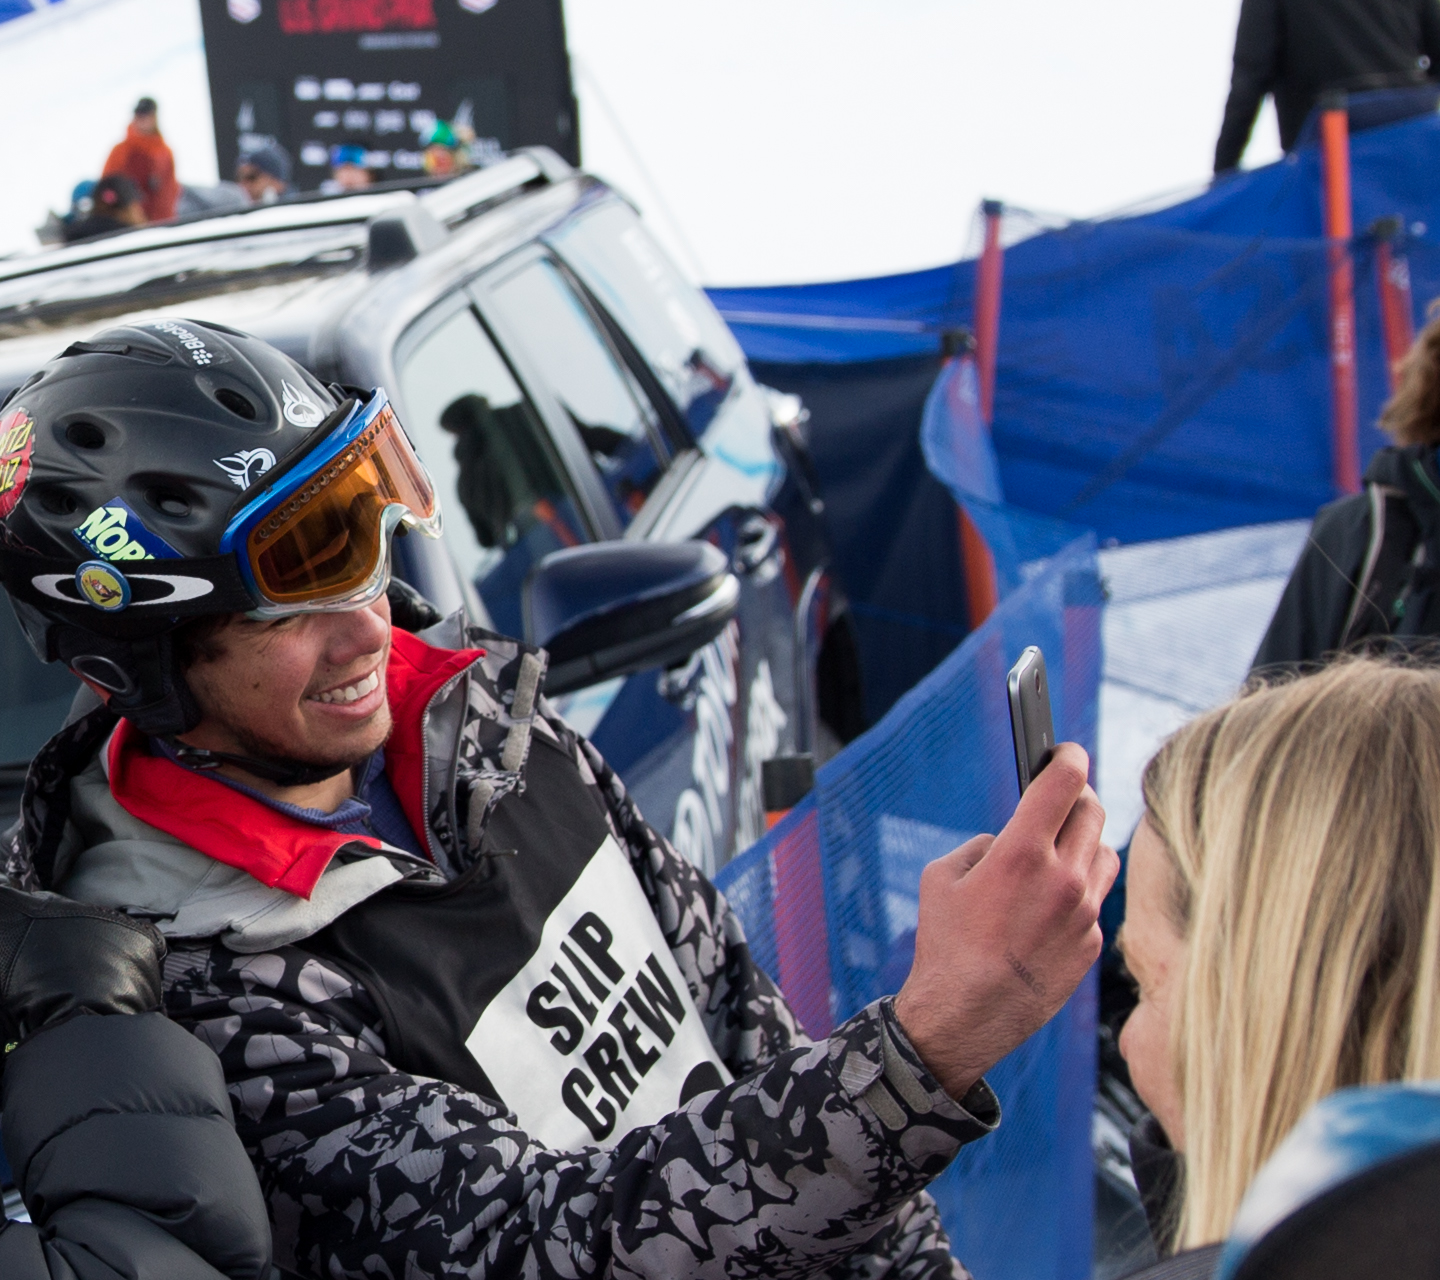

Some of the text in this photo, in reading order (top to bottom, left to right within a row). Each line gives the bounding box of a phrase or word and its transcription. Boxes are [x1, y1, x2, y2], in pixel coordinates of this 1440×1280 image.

[79, 506, 156, 560] NOR
[526, 911, 626, 1056] SLIP
[561, 952, 687, 1142] CREW
